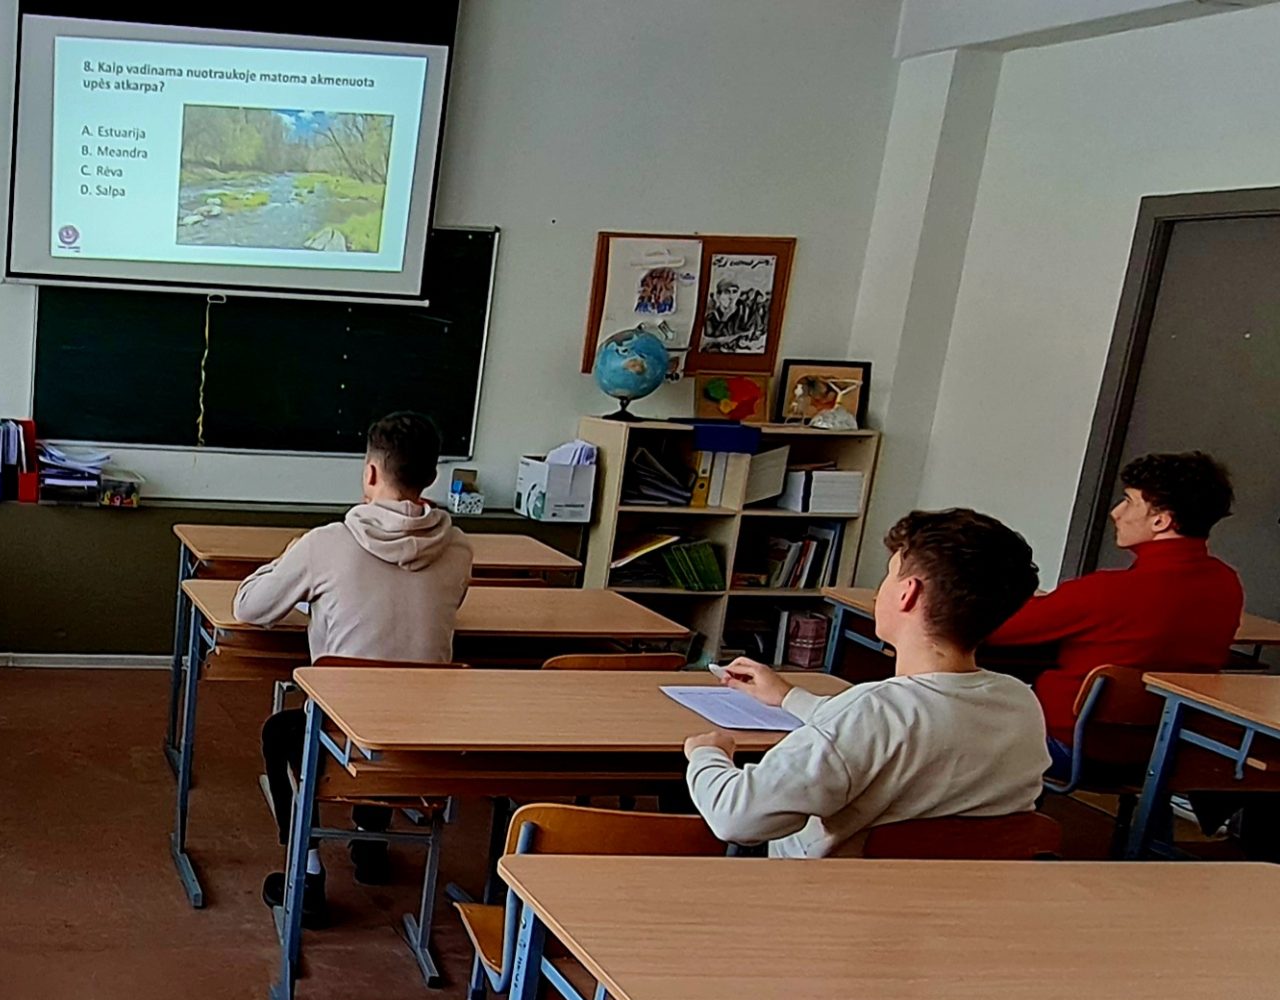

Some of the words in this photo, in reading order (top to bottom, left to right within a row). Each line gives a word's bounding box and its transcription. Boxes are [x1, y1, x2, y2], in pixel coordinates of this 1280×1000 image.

[83, 61, 94, 73] 8.
[98, 62, 124, 75] Kaip
[126, 64, 183, 77] vadinama
[186, 68, 256, 83] nuotraukoje
[259, 72, 307, 84] matoma
[310, 74, 375, 88] akmenuota
[114, 80, 165, 93] atkarpa?
[81, 125, 93, 136] A.
[97, 126, 146, 141] Estuarija
[81, 145, 92, 156] B.
[97, 146, 148, 159] Meandra
[80, 184, 92, 195] D.
[95, 185, 126, 198] Salpa
